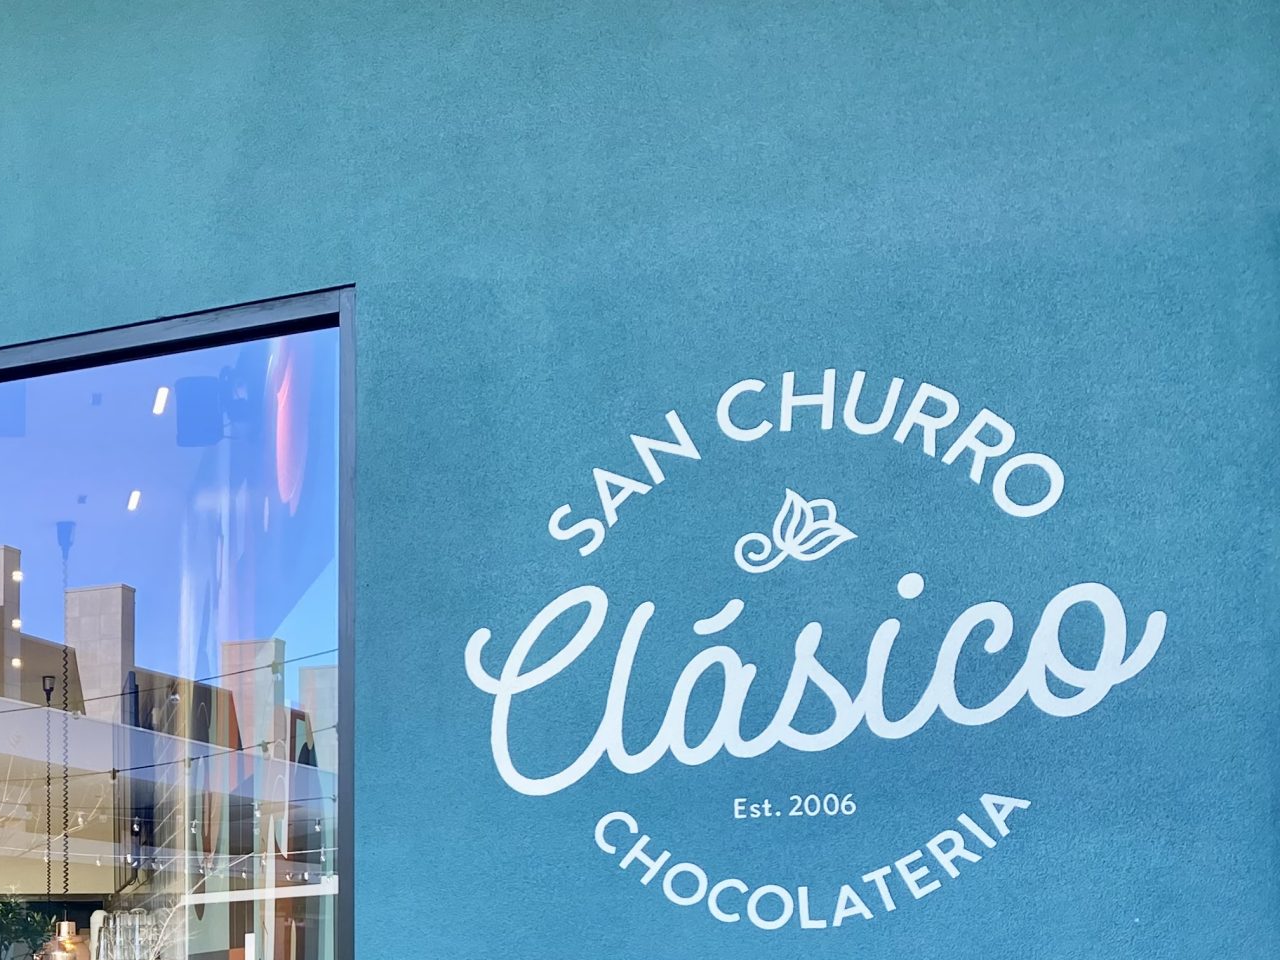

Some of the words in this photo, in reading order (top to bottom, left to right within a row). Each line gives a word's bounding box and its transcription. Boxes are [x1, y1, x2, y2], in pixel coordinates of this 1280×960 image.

[548, 410, 701, 556] SAN
[717, 368, 1064, 518] CHURRO
[465, 572, 1167, 796] Clásico
[594, 792, 1031, 929] CHOCOLATERIA
[733, 798, 781, 819] Est.
[789, 793, 857, 816] 2006
